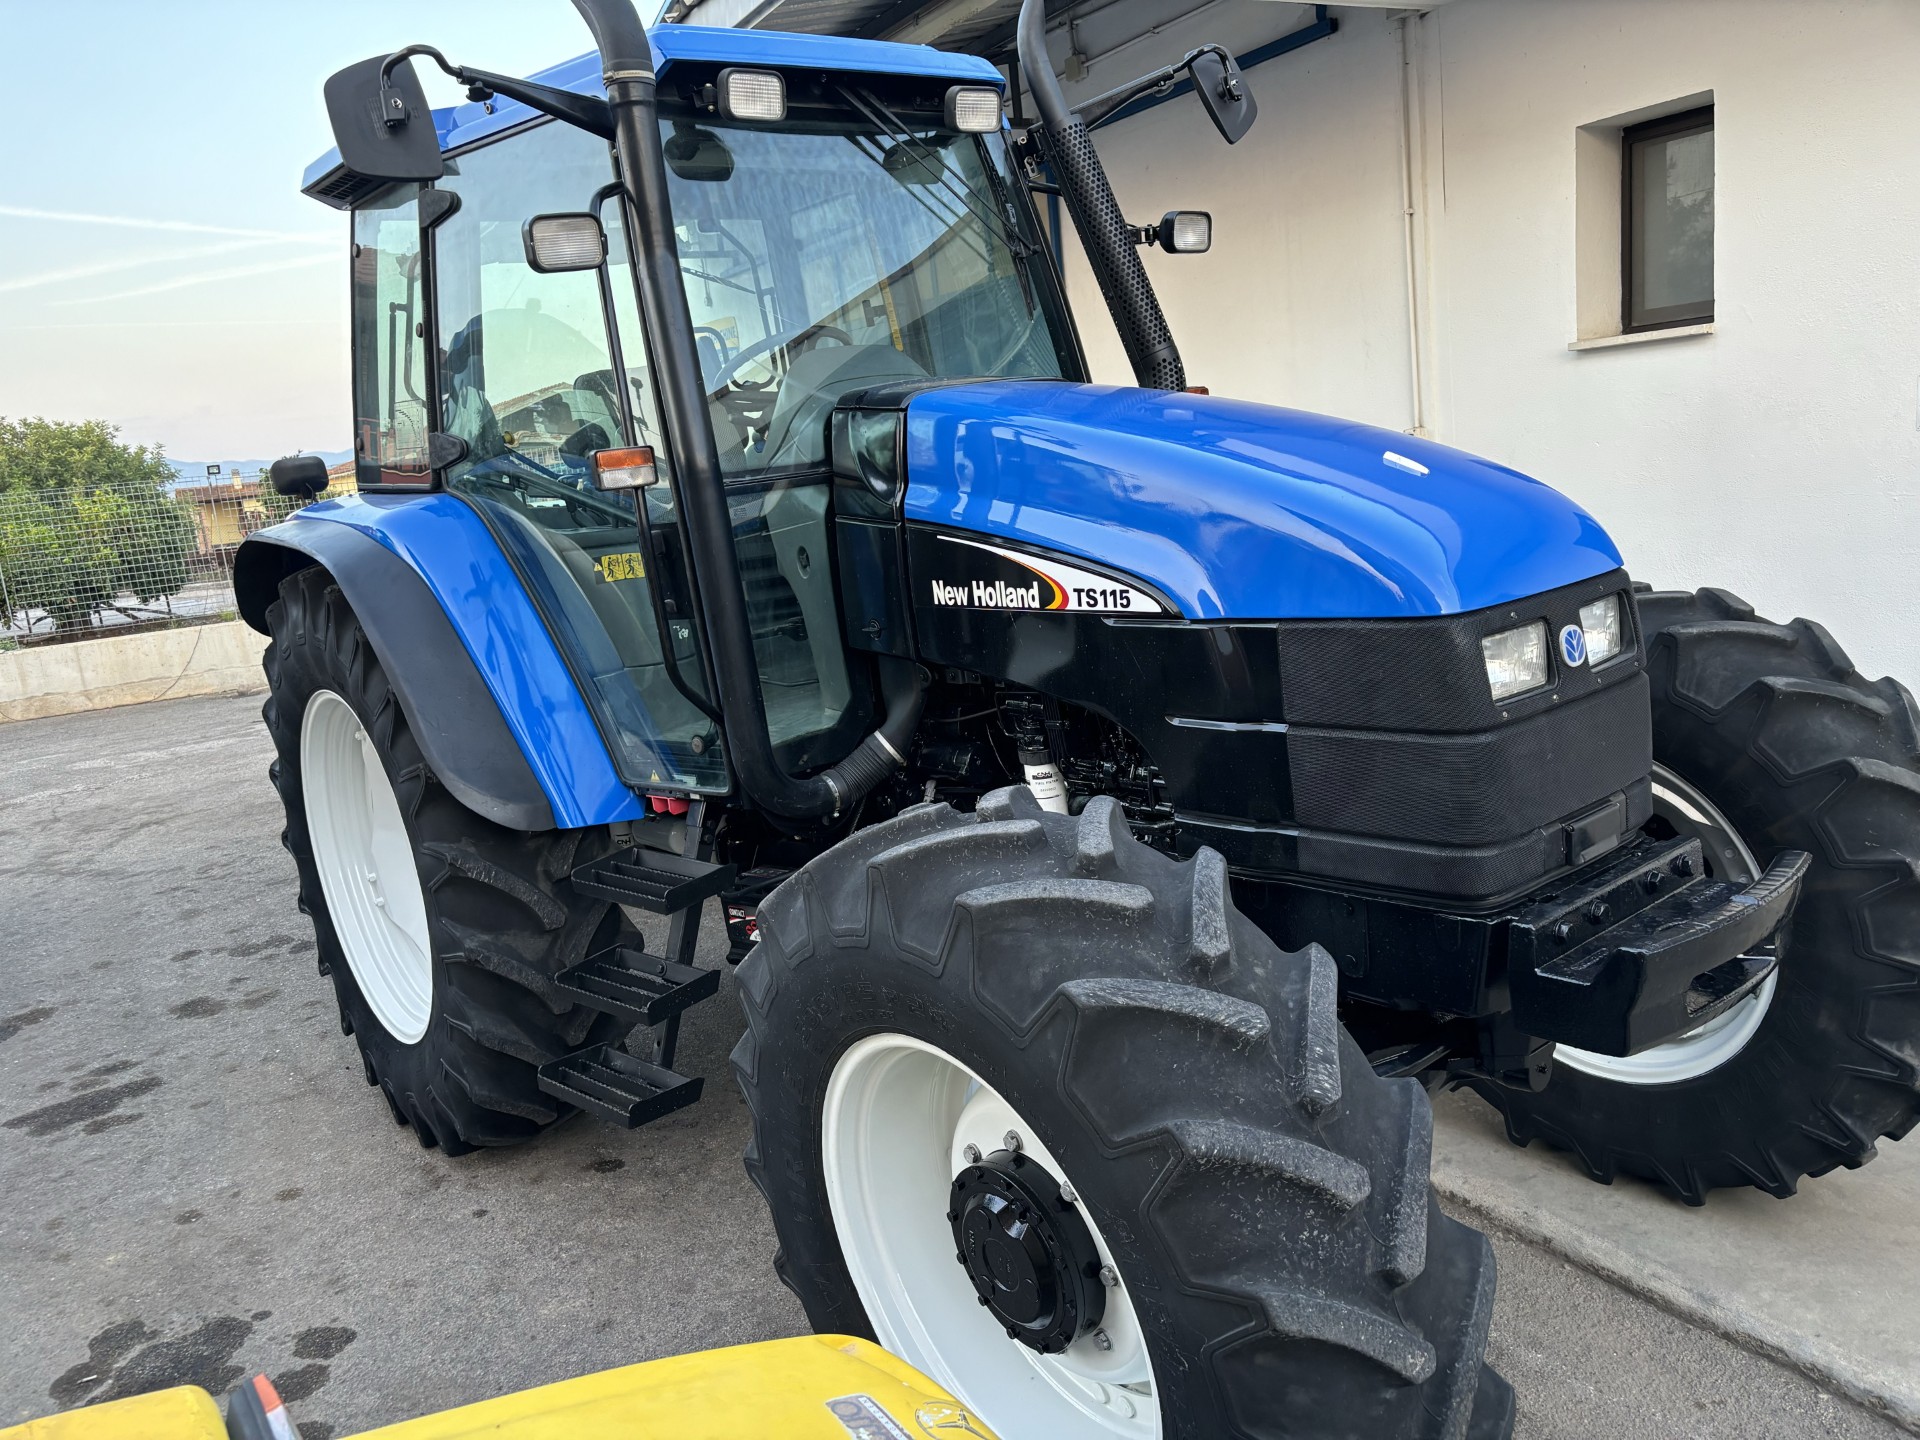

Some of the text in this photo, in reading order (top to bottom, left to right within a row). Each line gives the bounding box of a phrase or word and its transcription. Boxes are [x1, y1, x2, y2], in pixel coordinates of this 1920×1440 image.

[932, 580, 1131, 609] New Holland TS115
[616, 837, 632, 845] CNH
